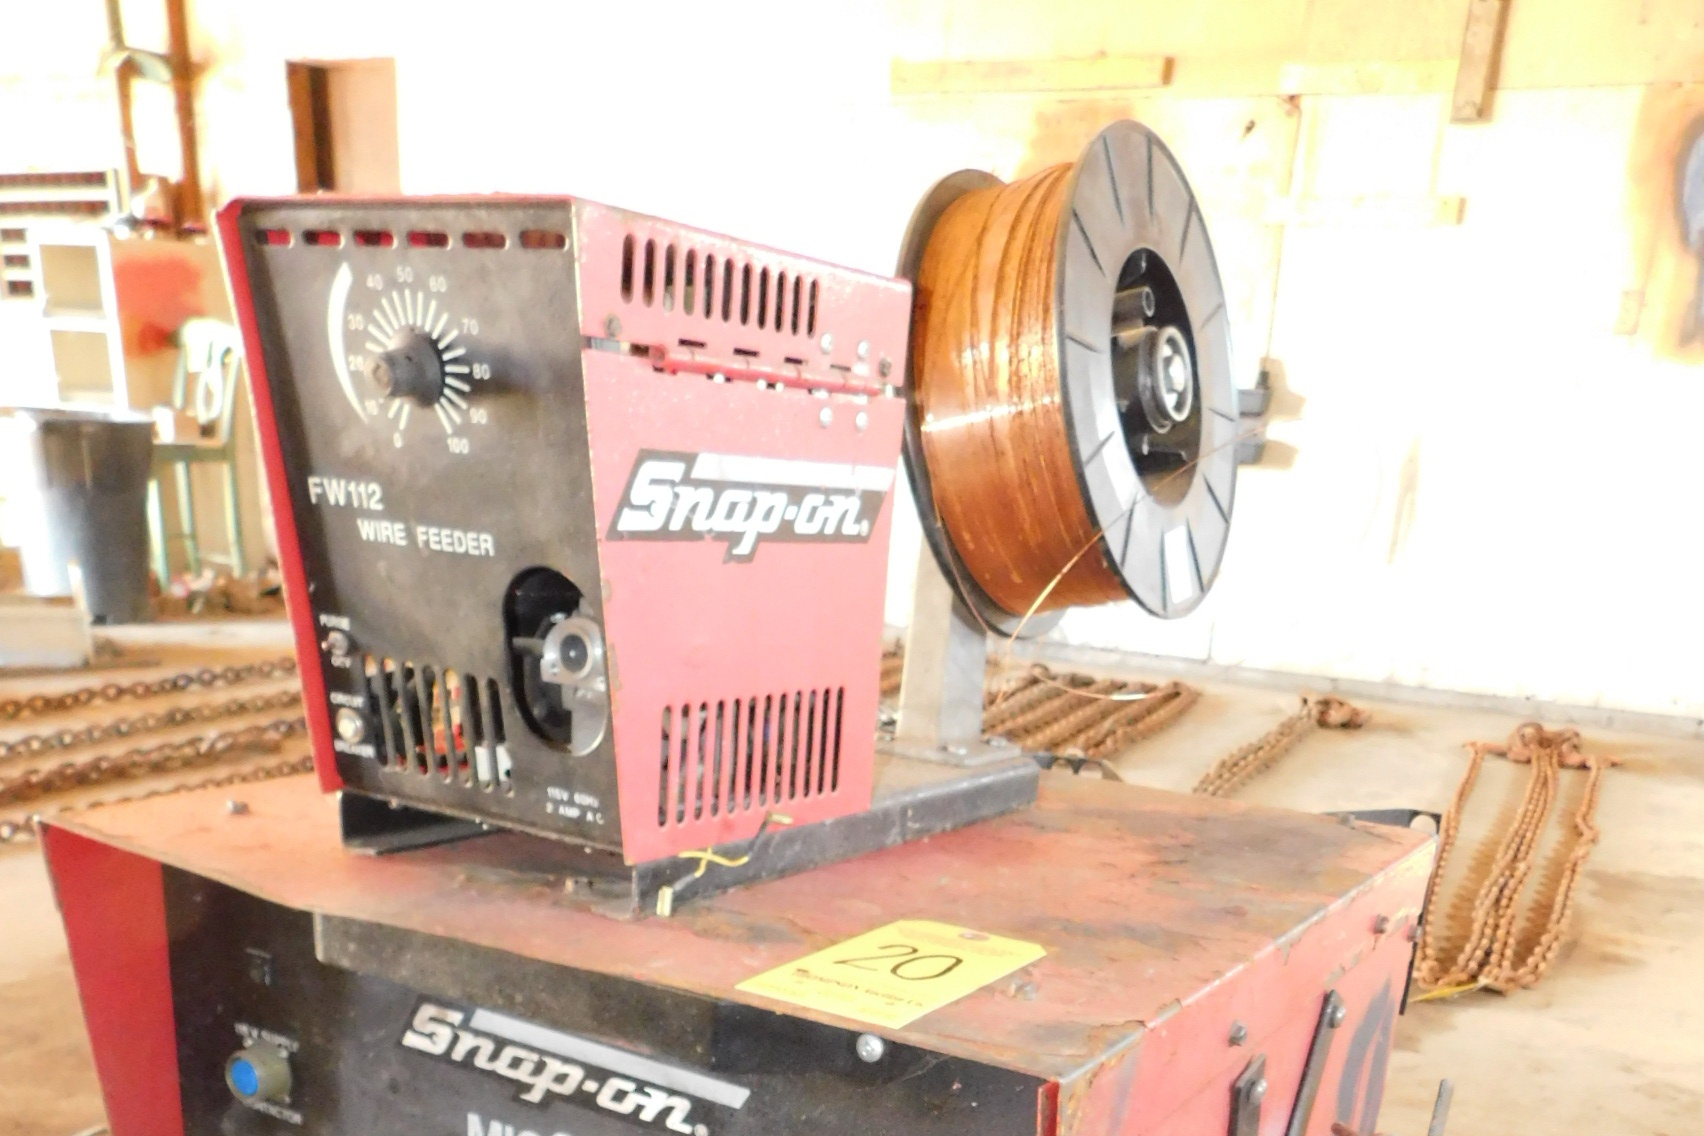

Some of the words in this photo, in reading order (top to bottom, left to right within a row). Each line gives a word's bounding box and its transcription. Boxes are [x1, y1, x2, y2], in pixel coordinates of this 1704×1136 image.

[366, 273, 383, 291] 40
[396, 266, 414, 283] 50
[428, 275, 447, 292] 60
[348, 314, 364, 331] 30
[461, 318, 479, 335] 70
[348, 355, 364, 372] 20
[472, 363, 491, 380] 80
[469, 408, 488, 425] 90
[392, 431, 403, 449] 0
[447, 437, 470, 454] 100
[307, 476, 385, 511] FW112
[356, 518, 408, 546] WIRE
[416, 526, 496, 557] FEEDER
[832, 943, 964, 981] 20
